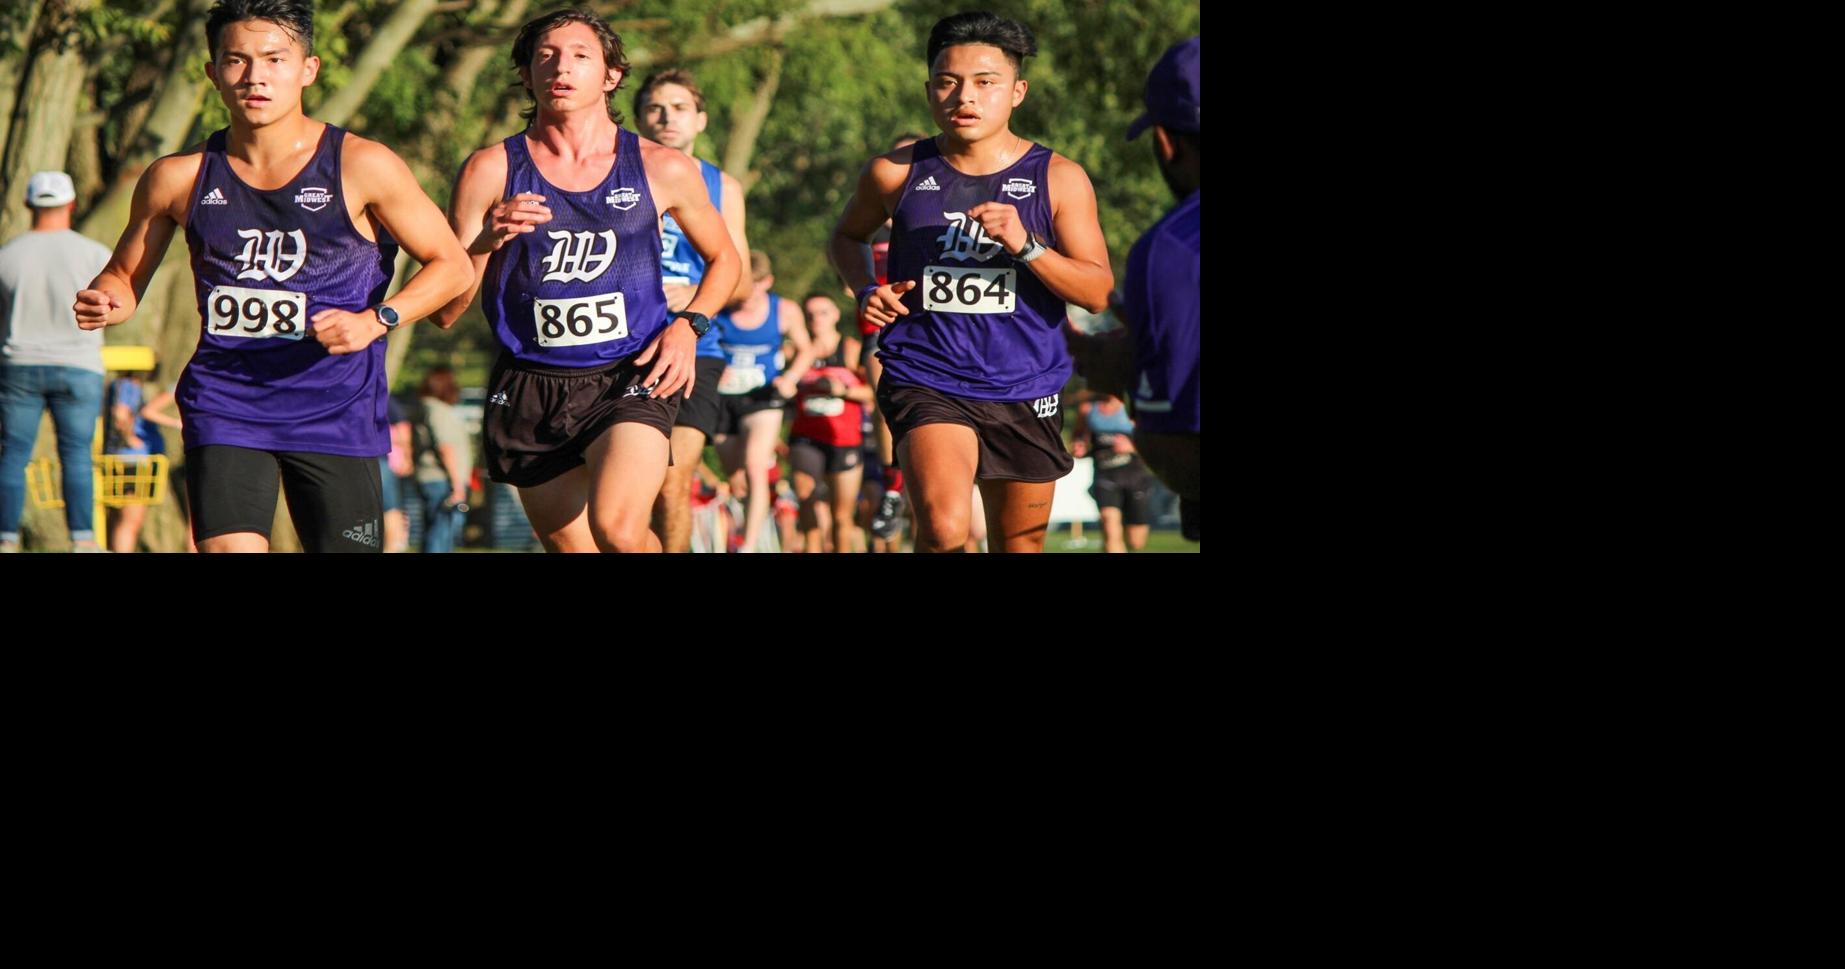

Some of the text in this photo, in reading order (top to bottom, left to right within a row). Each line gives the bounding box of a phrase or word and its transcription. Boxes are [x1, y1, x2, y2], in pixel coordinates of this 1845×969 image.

[294, 194, 333, 203] MIDWEST
[235, 229, 307, 283] W
[541, 228, 617, 284] W
[929, 271, 1010, 306] 864
[214, 294, 299, 333] 998
[541, 299, 619, 339] 865
